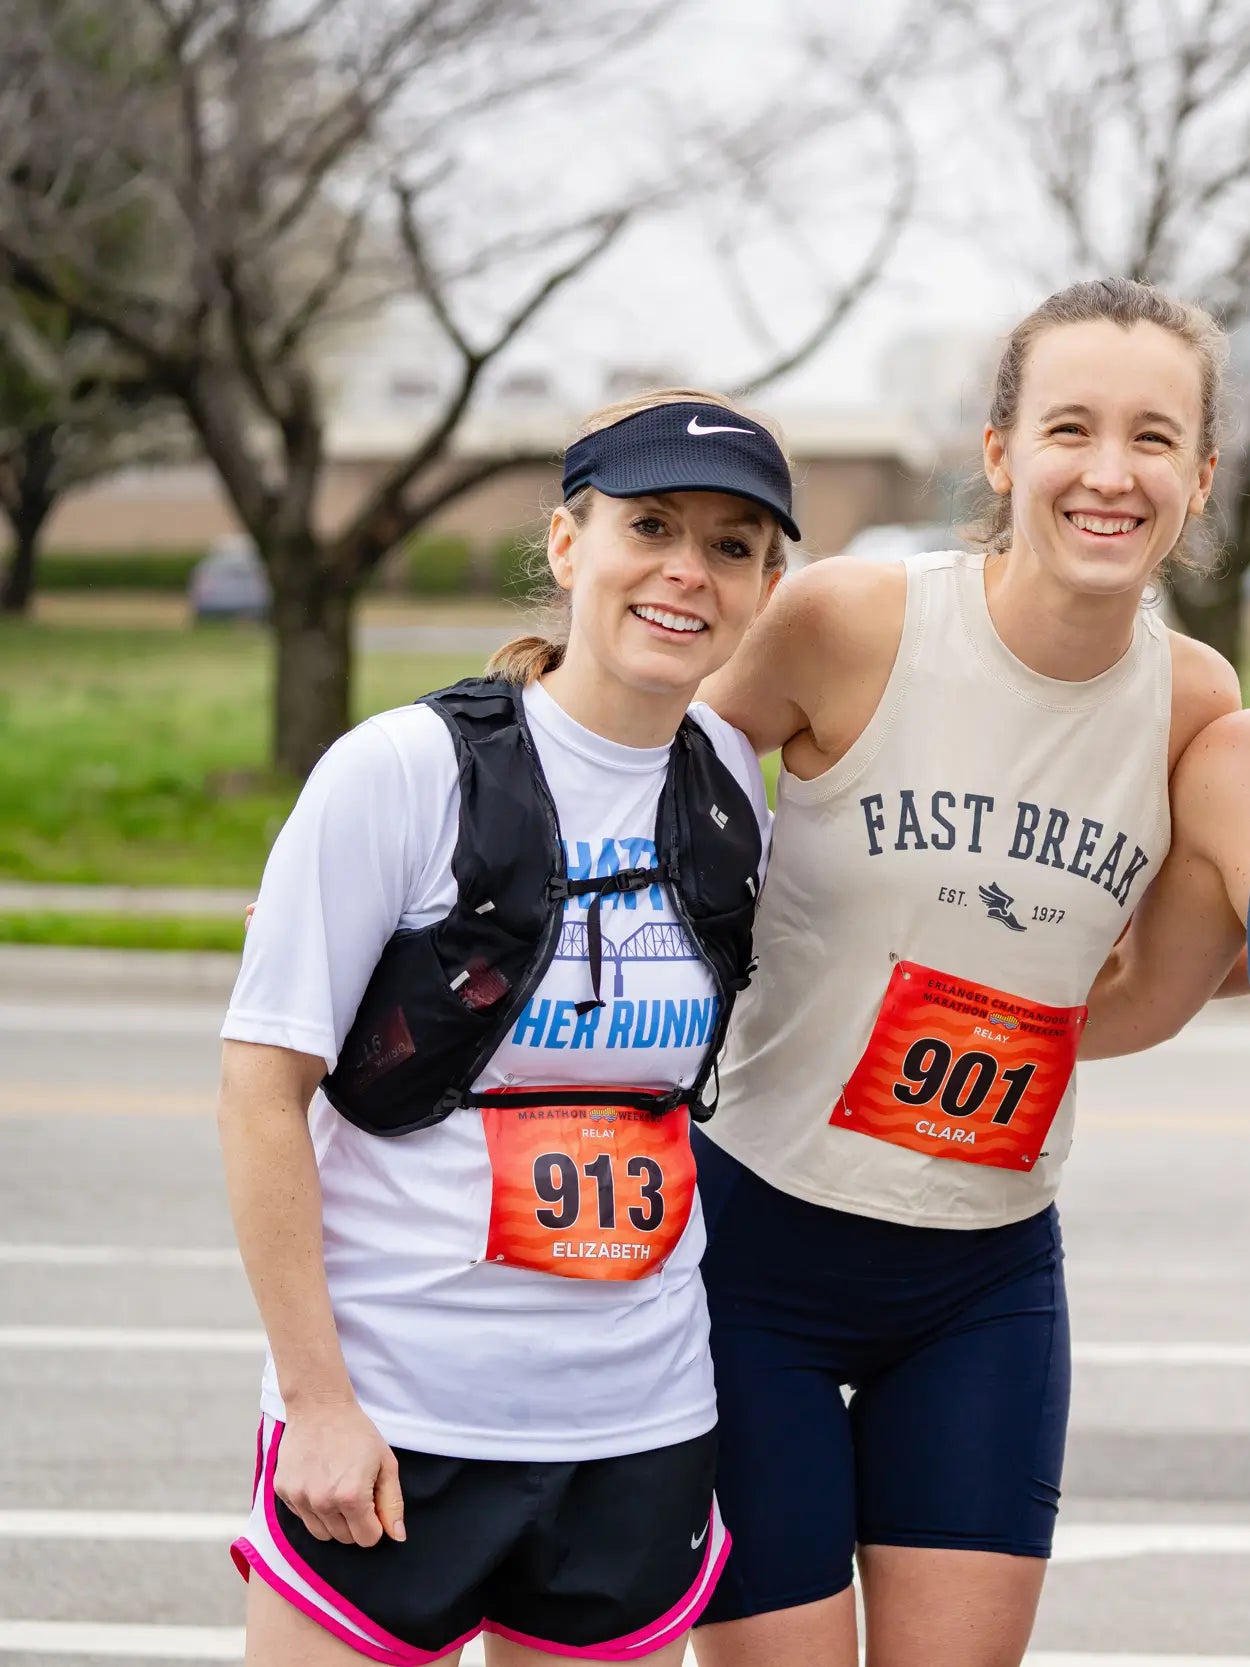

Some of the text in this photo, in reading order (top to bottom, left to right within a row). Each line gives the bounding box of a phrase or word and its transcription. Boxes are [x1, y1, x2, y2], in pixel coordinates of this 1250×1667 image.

[860, 790, 1149, 908] FAST BREAK
[938, 887, 1065, 924] EST. 1977
[927, 979, 990, 1004] ERLANGER
[923, 993, 1065, 1037] MARATHON WEEKEND
[973, 1026, 1010, 1043] RELAY
[892, 1036, 1037, 1126] 901
[518, 1109, 587, 1120] MARATHON
[582, 1129, 615, 1138] RELAY
[915, 1120, 976, 1145] CLARA
[533, 1152, 665, 1232] 913
[552, 1242, 650, 1260] ELIZABETH
